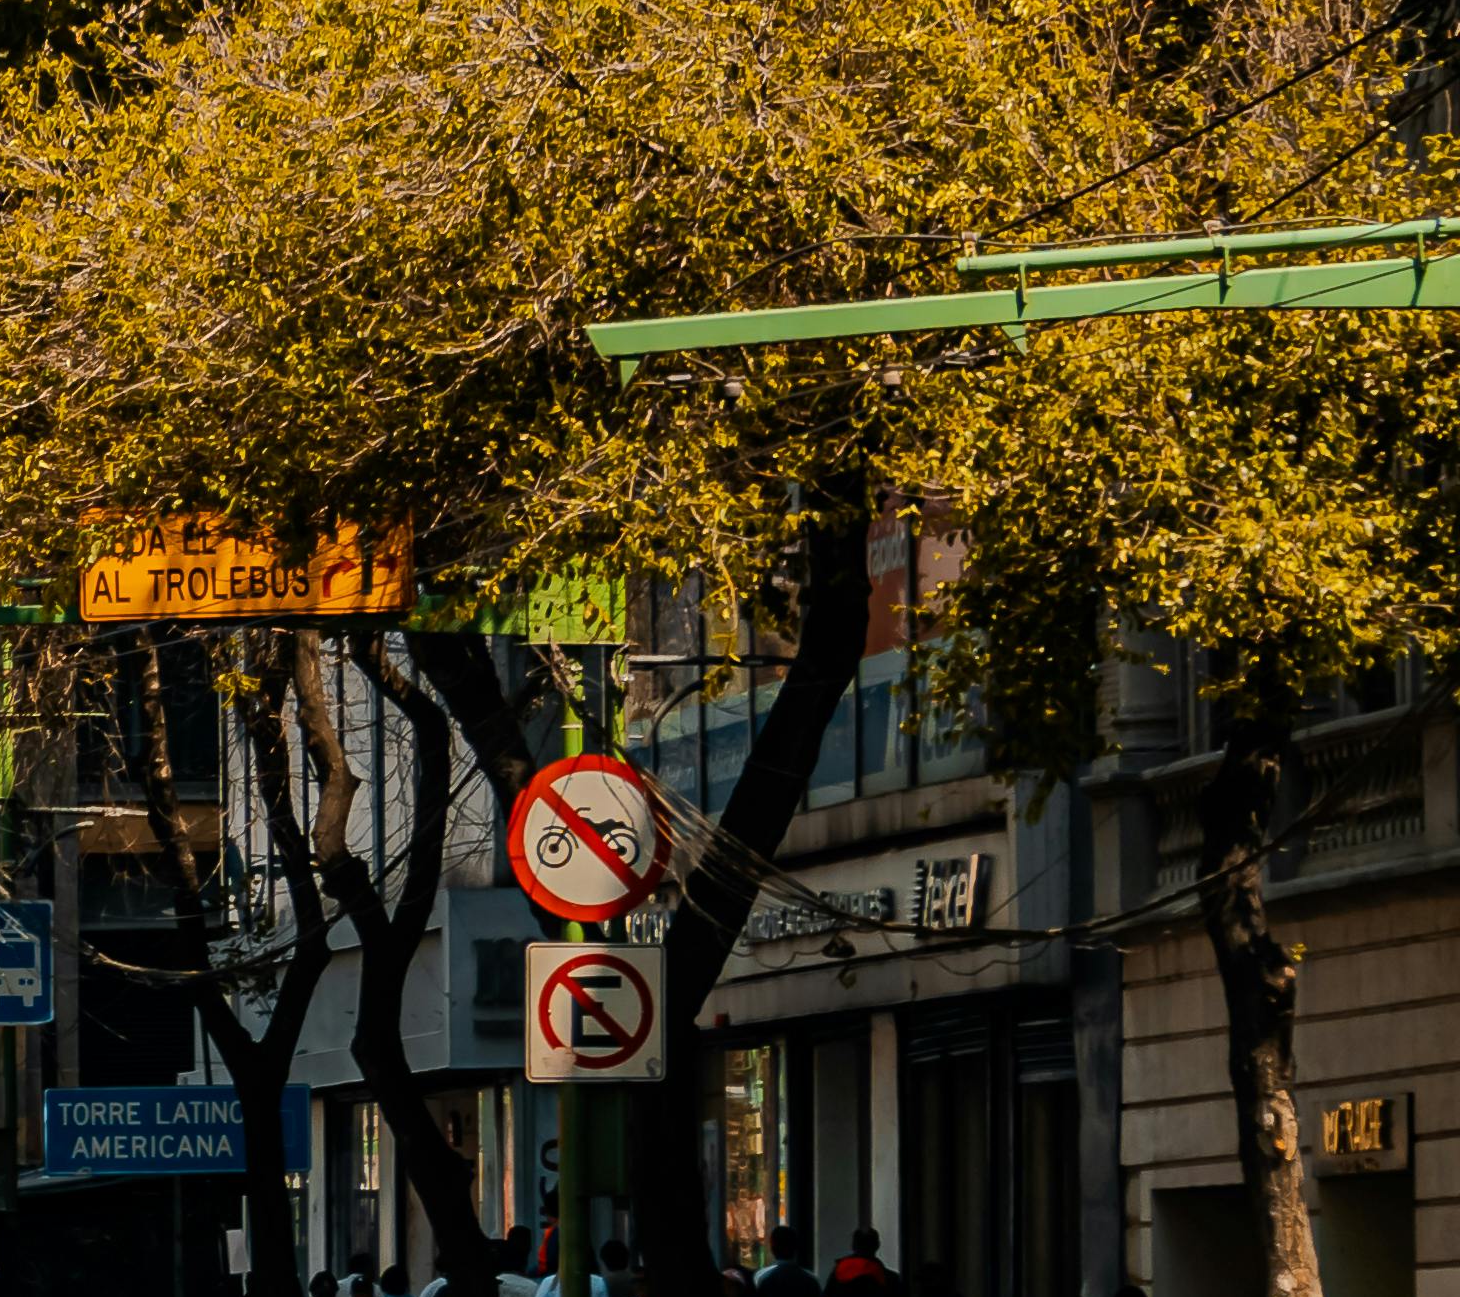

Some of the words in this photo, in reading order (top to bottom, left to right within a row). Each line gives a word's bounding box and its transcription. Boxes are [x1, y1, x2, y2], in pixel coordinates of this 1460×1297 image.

[92, 570, 131, 603] AL
[148, 566, 310, 603] TROLEBUS
[59, 1102, 141, 1126] TORRE
[71, 1135, 233, 1159] AMERICANA
